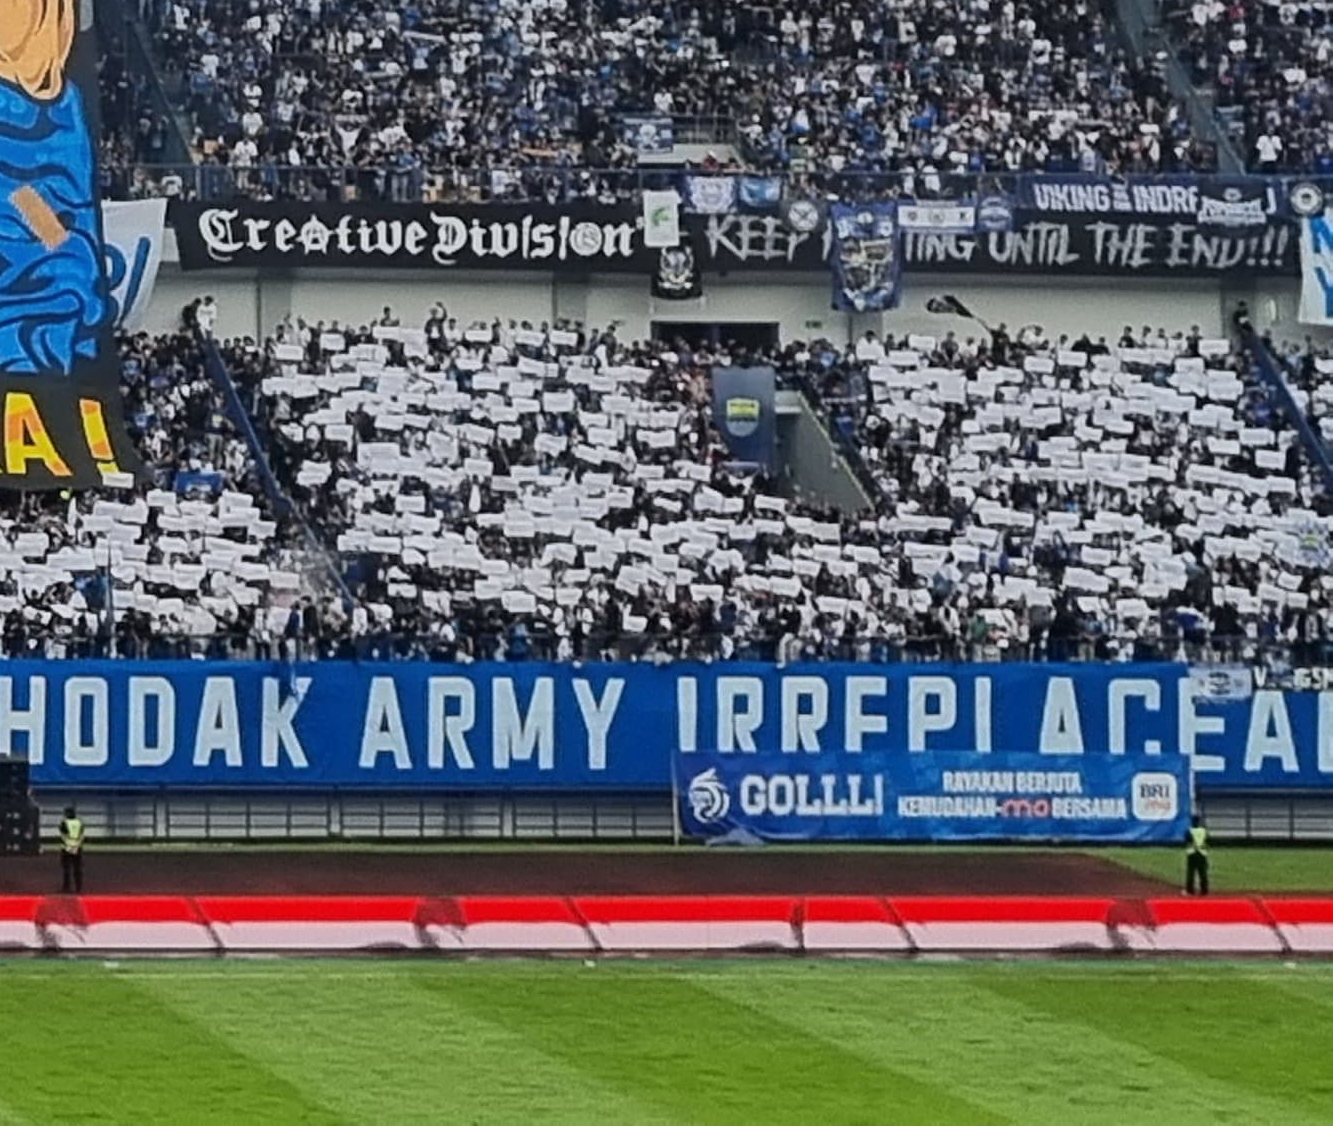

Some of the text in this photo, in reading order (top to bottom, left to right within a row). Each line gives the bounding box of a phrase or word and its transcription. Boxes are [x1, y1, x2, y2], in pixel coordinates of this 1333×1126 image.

[1033, 183, 1110, 212] VIKING
[1084, 221, 1158, 268] THE
[359, 675, 625, 770] ARMY
[679, 676, 1333, 772] IRREPLACEA
[739, 773, 884, 817] GOLLL!
[1052, 797, 1127, 819] BERSAMA
[1139, 783, 1171, 799] BRI
